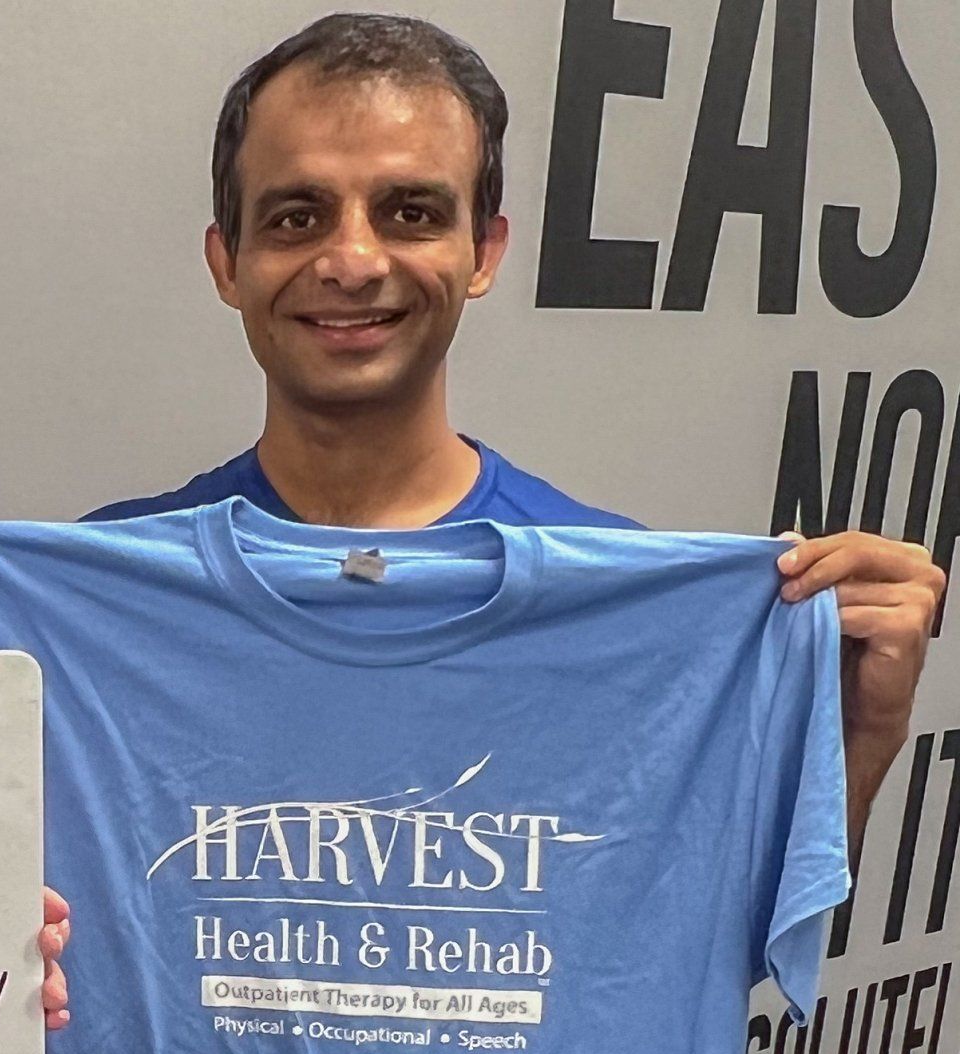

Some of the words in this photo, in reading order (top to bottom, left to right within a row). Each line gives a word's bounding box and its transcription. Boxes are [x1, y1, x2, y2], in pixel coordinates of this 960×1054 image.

[770, 369, 960, 638] NO
[191, 803, 559, 892] HARVEST
[194, 915, 340, 966] Health
[358, 922, 390, 968] &
[406, 925, 553, 976] Rehab
[214, 981, 320, 1003] Outpatient
[324, 989, 407, 1013] Therapy
[412, 992, 440, 1012] for
[445, 995, 473, 1013] All
[478, 996, 528, 1016] Ages
[214, 1015, 284, 1036] Physical
[308, 1021, 431, 1045] Occupational
[457, 1030, 527, 1050] Speech
